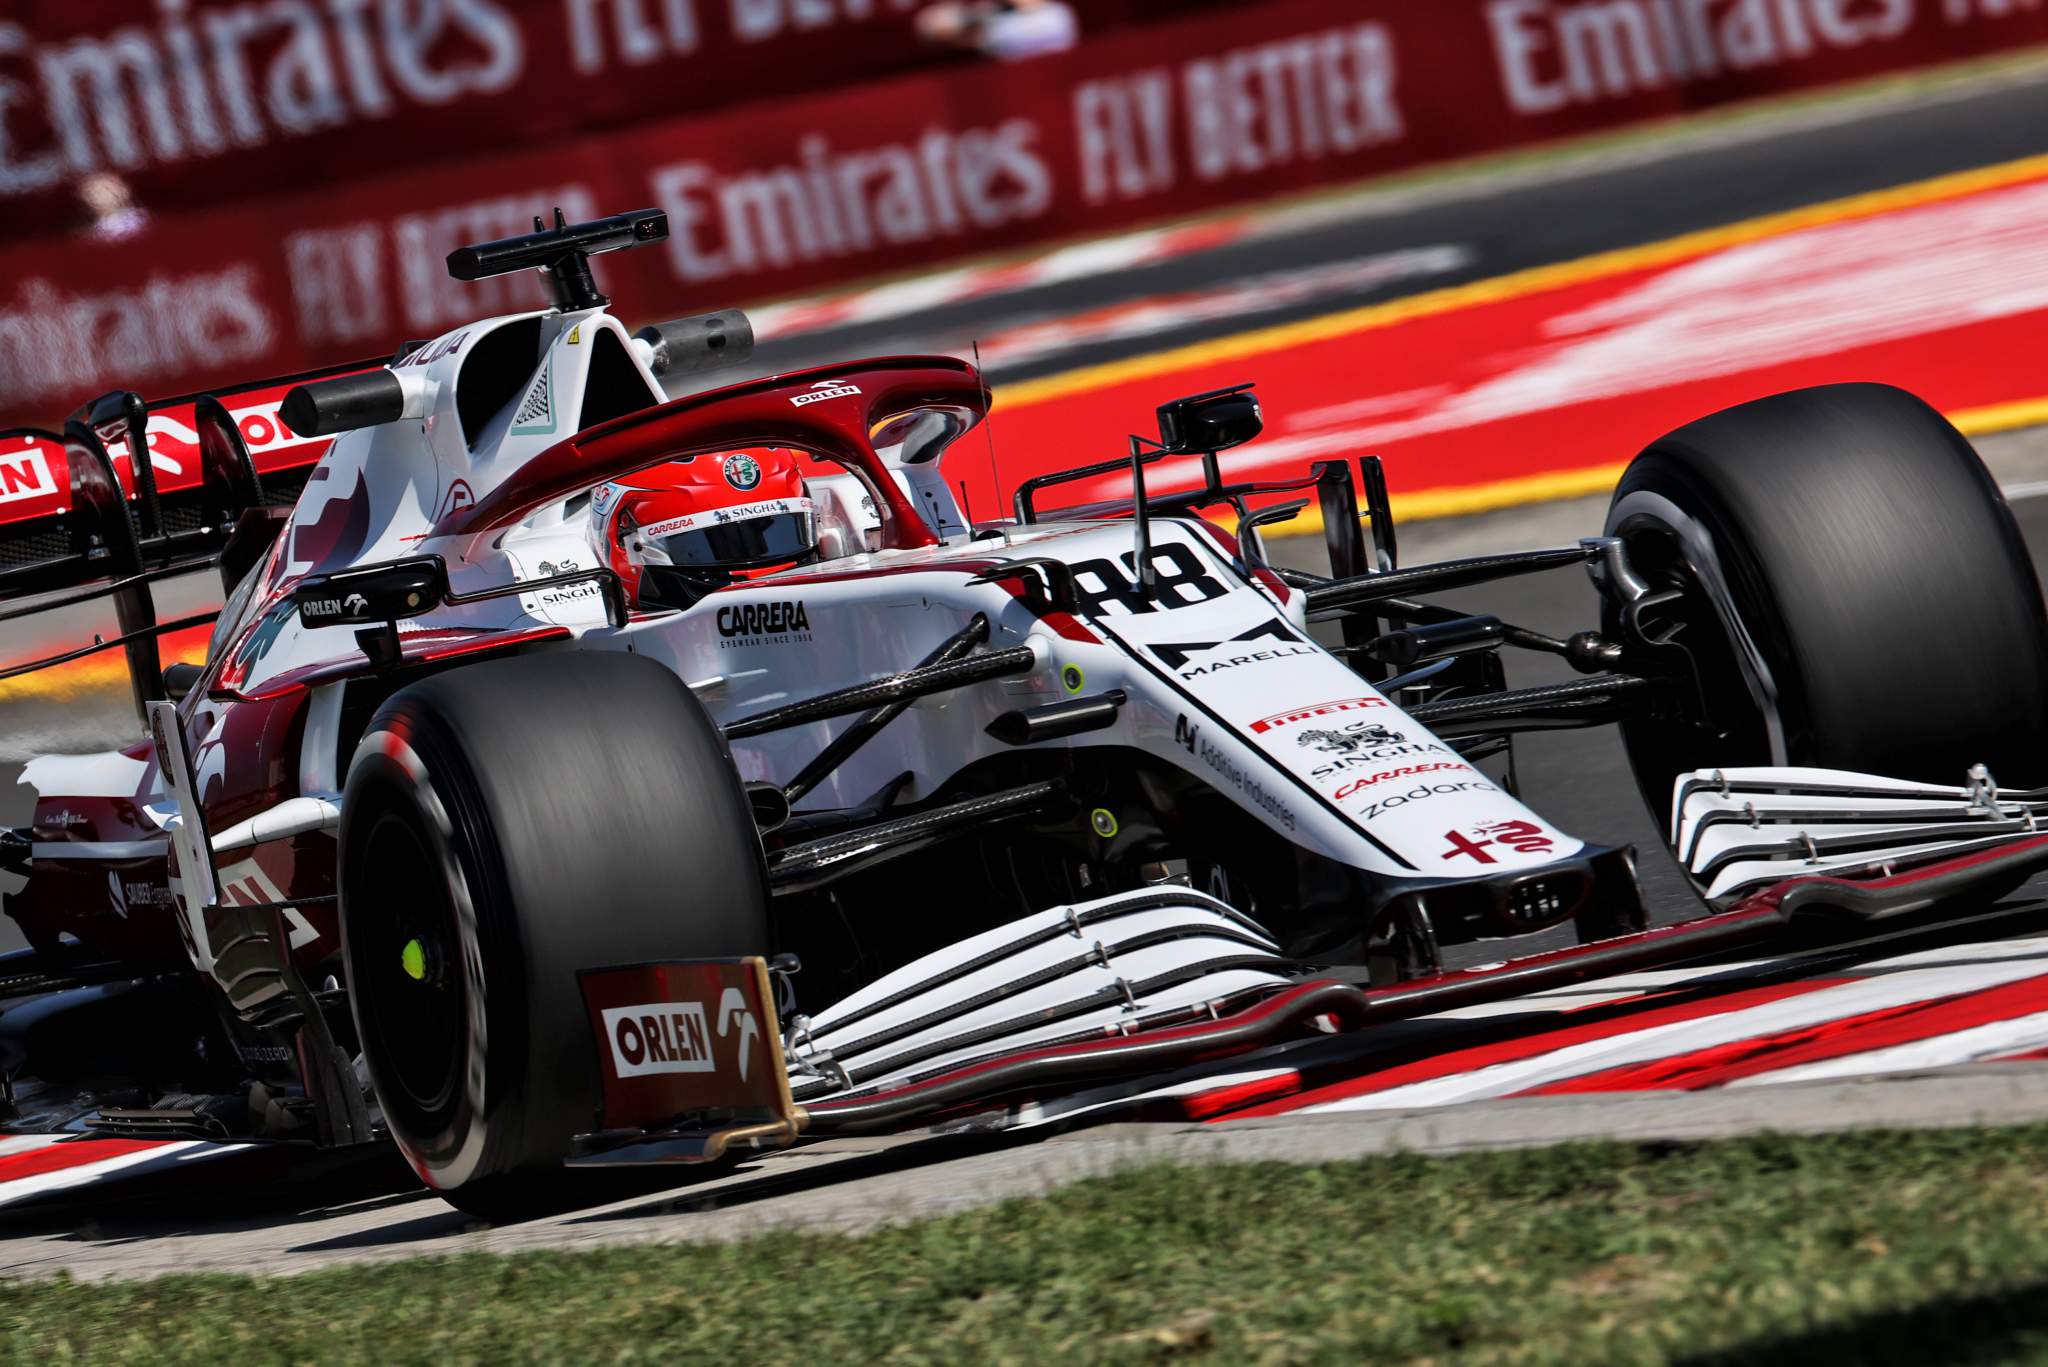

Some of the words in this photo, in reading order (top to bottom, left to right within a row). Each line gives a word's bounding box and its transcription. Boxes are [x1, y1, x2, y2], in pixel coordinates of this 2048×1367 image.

[650, 118, 1052, 284] Emirates
[1073, 66, 1178, 202] FLY
[1182, 22, 1407, 182] BETTER
[796, 386, 856, 403] ORLEN
[647, 518, 695, 536] CARRERA
[732, 502, 777, 518] SINGHA
[302, 598, 343, 617] ORLEN
[716, 600, 811, 638] CARRERA
[1180, 645, 1319, 681] MARELLI
[1248, 697, 1389, 734] PIRELLI
[1310, 743, 1446, 777] SINGHA
[1200, 738, 1243, 790] Additive
[1242, 771, 1296, 832] Industries
[1333, 762, 1476, 800] CARRERA
[1359, 781, 1497, 820] zadara
[616, 1013, 707, 1066] ORLEN
